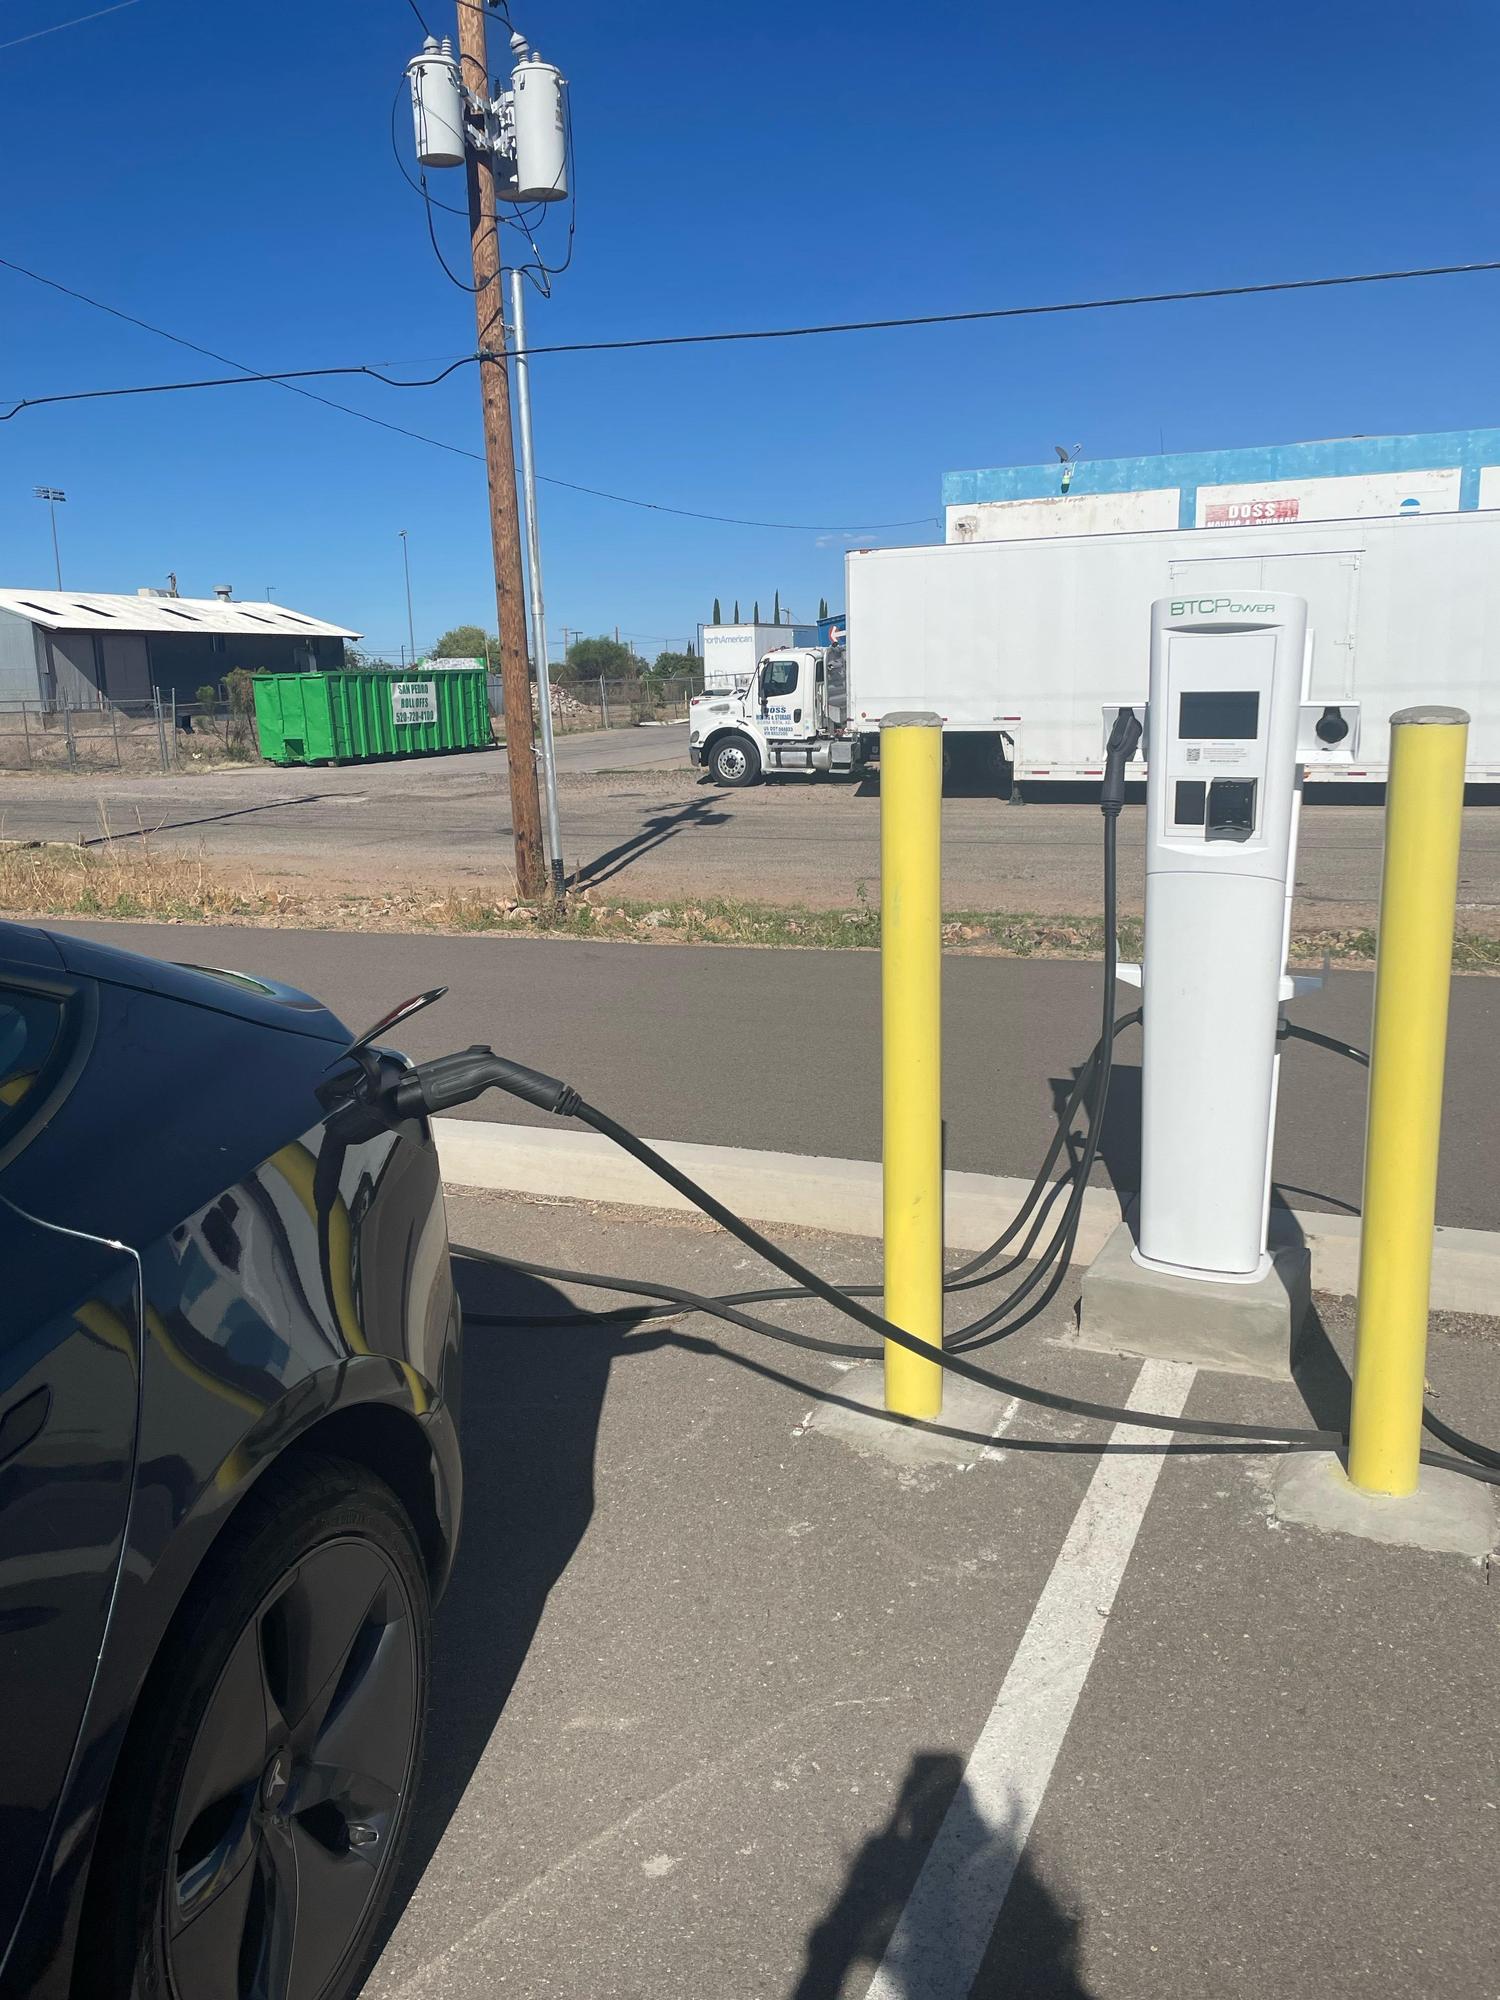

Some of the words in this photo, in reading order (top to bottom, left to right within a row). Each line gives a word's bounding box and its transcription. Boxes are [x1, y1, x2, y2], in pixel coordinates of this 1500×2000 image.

[1229, 503, 1276, 518] DOSS
[398, 684, 410, 695] SAN
[411, 684, 429, 694] PEDRO
[401, 698, 415, 708] ROLL
[416, 697, 429, 707] OFFS
